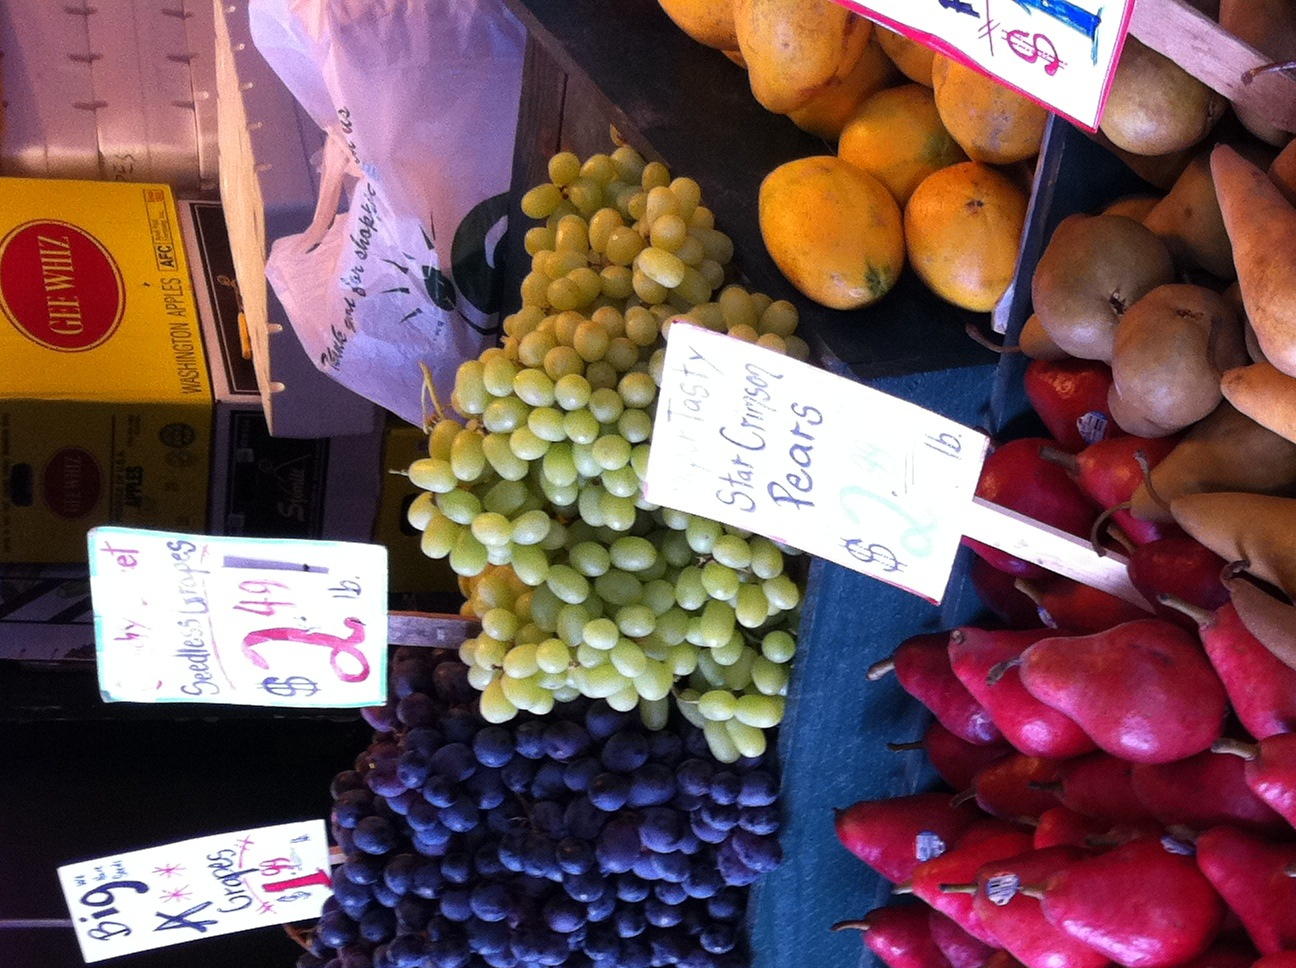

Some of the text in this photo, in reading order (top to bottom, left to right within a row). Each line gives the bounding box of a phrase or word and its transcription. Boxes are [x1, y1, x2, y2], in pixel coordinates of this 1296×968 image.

[338, 106, 352, 133] us
[38, 235, 83, 334] GEE WHIZ
[157, 245, 174, 268] AFC
[340, 266, 366, 297] for
[160, 277, 186, 317] APPLES
[169, 322, 201, 394] WASHINGTON
[667, 346, 724, 423] Tasty
[715, 363, 783, 513] Star Crimson
[767, 402, 823, 509] Pears
[172, 619, 220, 696] Seedless
[79, 880, 150, 941] Big
[206, 848, 259, 913] Grapes
